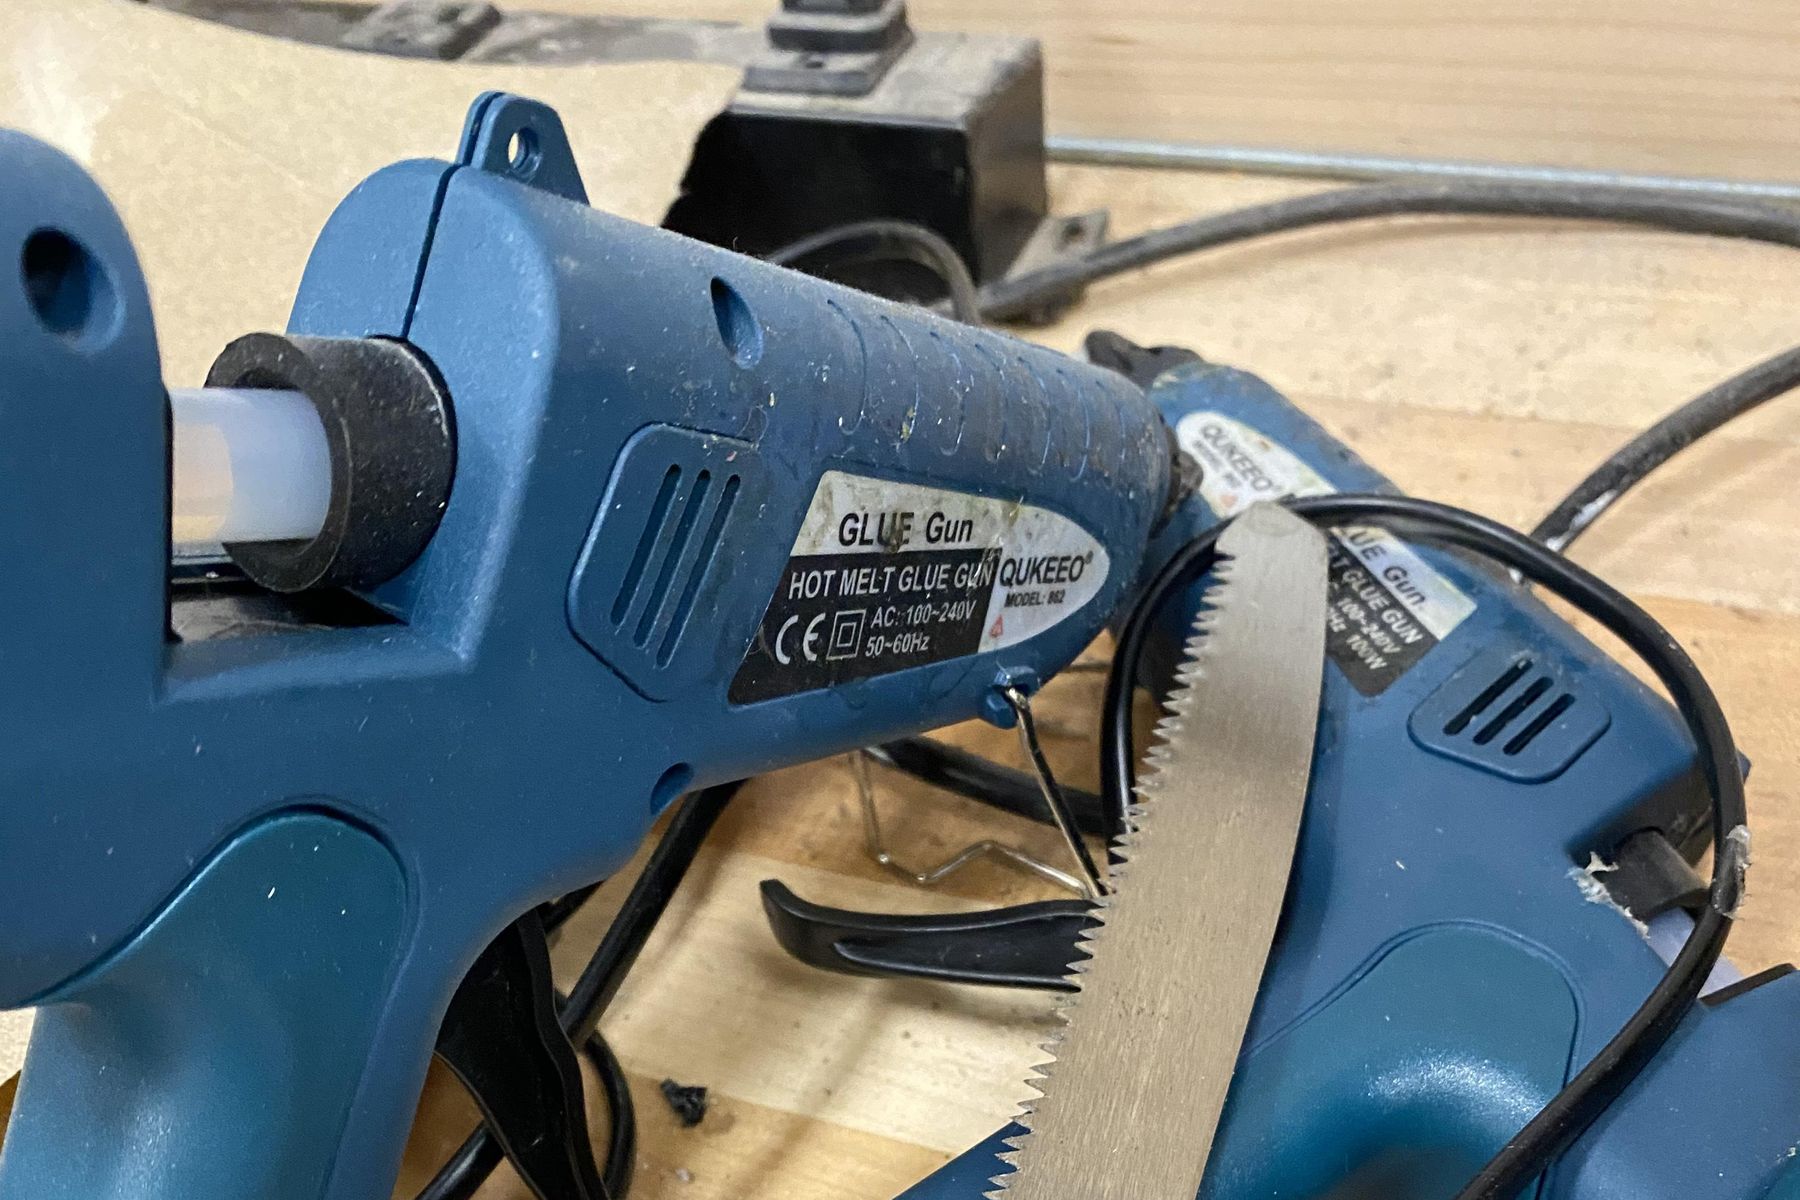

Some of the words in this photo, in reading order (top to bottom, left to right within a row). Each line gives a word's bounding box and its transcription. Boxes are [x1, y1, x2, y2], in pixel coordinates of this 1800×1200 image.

[838, 512, 915, 546] GLUE
[926, 511, 974, 543] Gun
[788, 568, 837, 600] HOT
[838, 565, 896, 596] MELT
[898, 563, 951, 592] GLUE
[953, 559, 995, 588] GUN
[1383, 566, 1426, 606] Gun
[870, 606, 900, 629] AC:
[905, 600, 977, 626] 100~240V
[1004, 591, 1045, 608] MODEL:
[1342, 568, 1390, 610] GLUE
[1381, 609, 1424, 644] GUN
[865, 634, 930, 658] 50~60Hz
[1346, 633, 1388, 670] 100W
